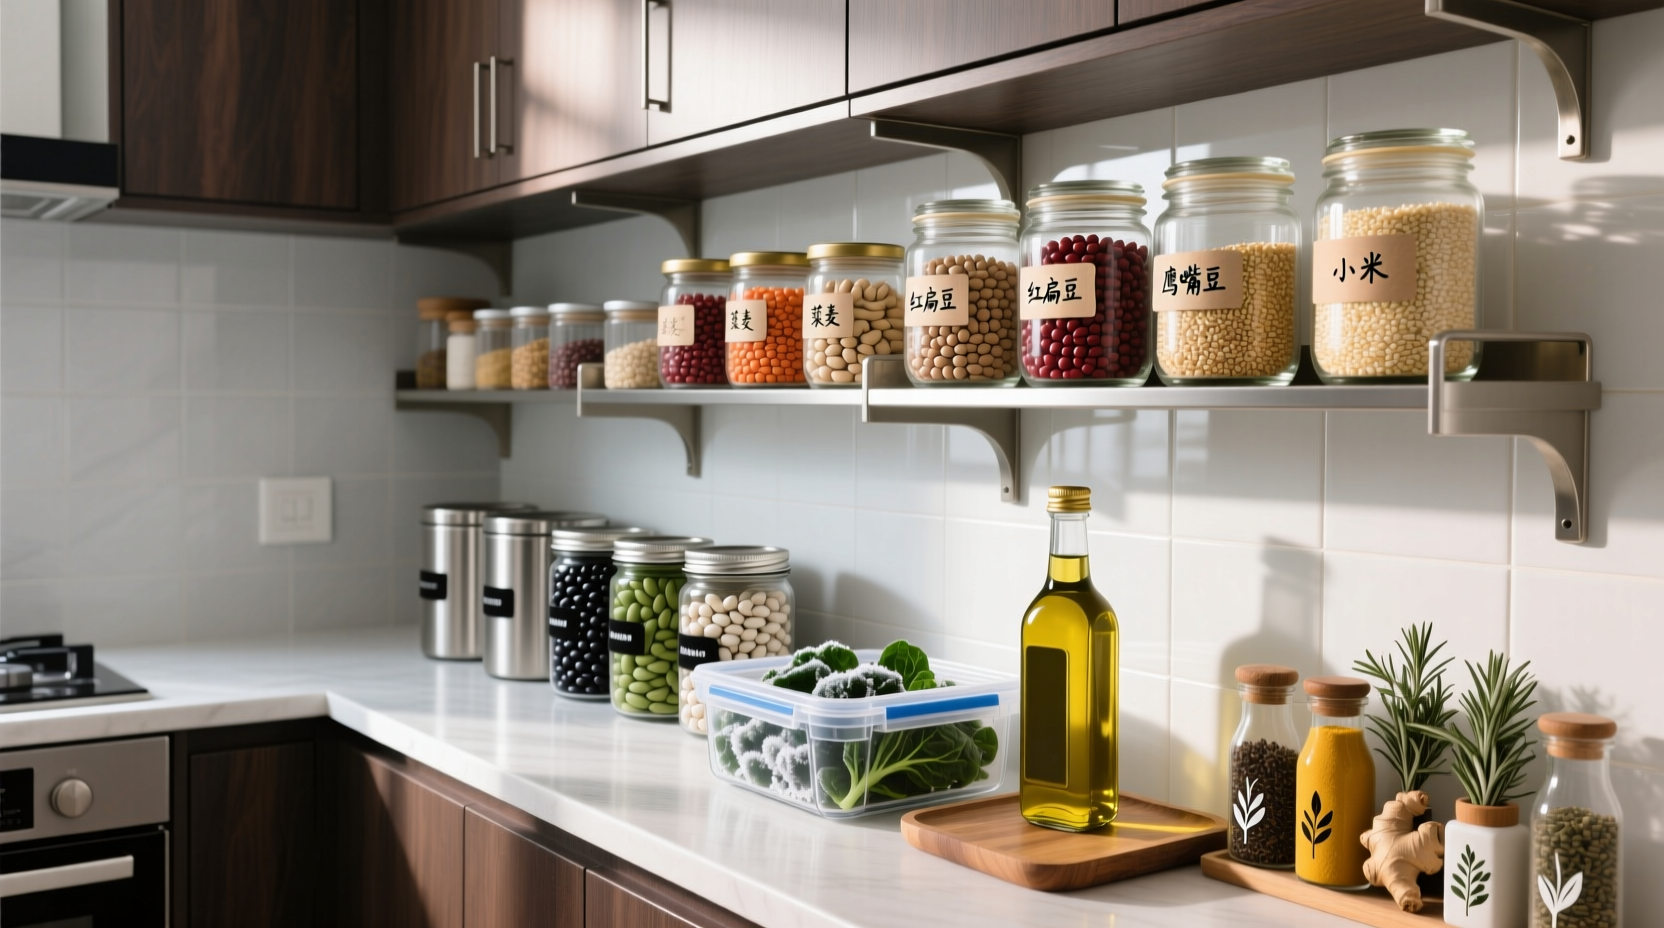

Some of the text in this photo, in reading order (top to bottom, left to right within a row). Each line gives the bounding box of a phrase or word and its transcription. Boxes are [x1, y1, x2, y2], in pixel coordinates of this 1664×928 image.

[1333, 252, 1390, 285] 小米
[910, 287, 957, 313] 红扁豆
[1028, 276, 1083, 305] 红扁豆
